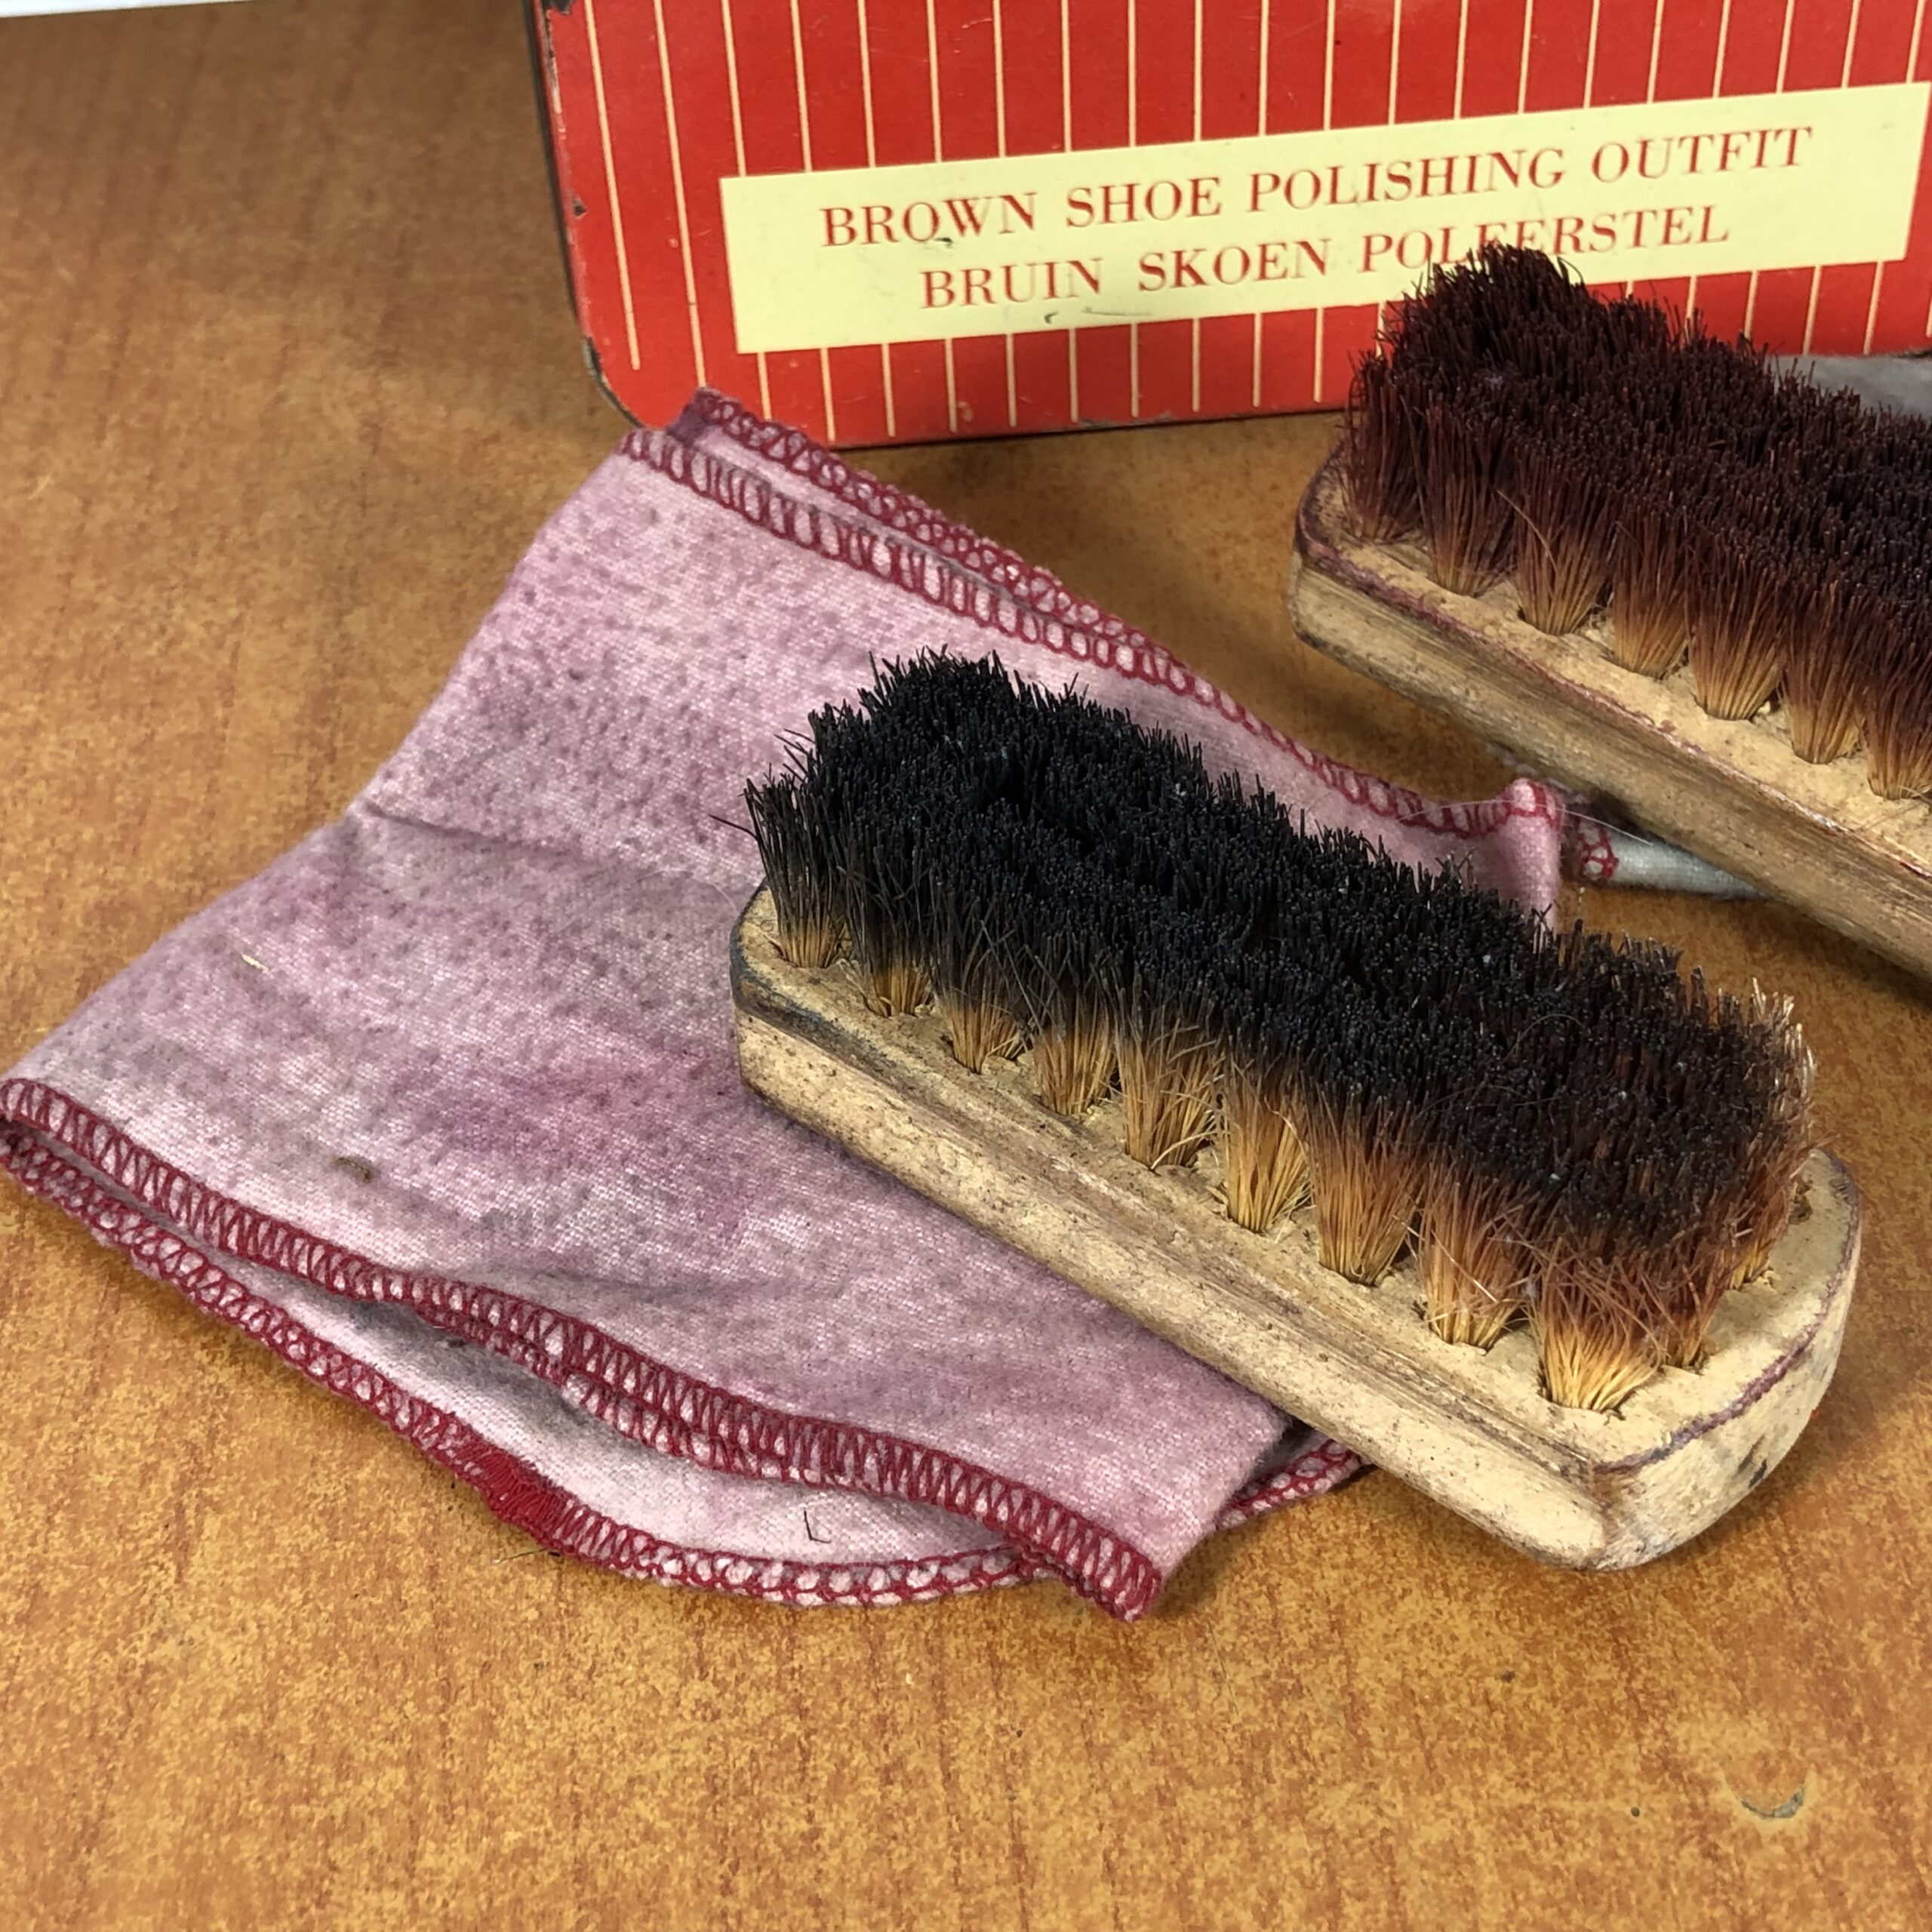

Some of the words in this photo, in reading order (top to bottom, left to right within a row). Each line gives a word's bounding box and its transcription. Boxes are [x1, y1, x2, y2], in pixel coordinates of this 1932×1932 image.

[820, 191, 1037, 247] BROWN
[1065, 177, 1222, 228] SHOE
[1247, 146, 1564, 214] POLISHING
[1590, 126, 1813, 183] OUTFIT
[919, 257, 1103, 309] BRUIN
[1137, 239, 1331, 291] SKOEN
